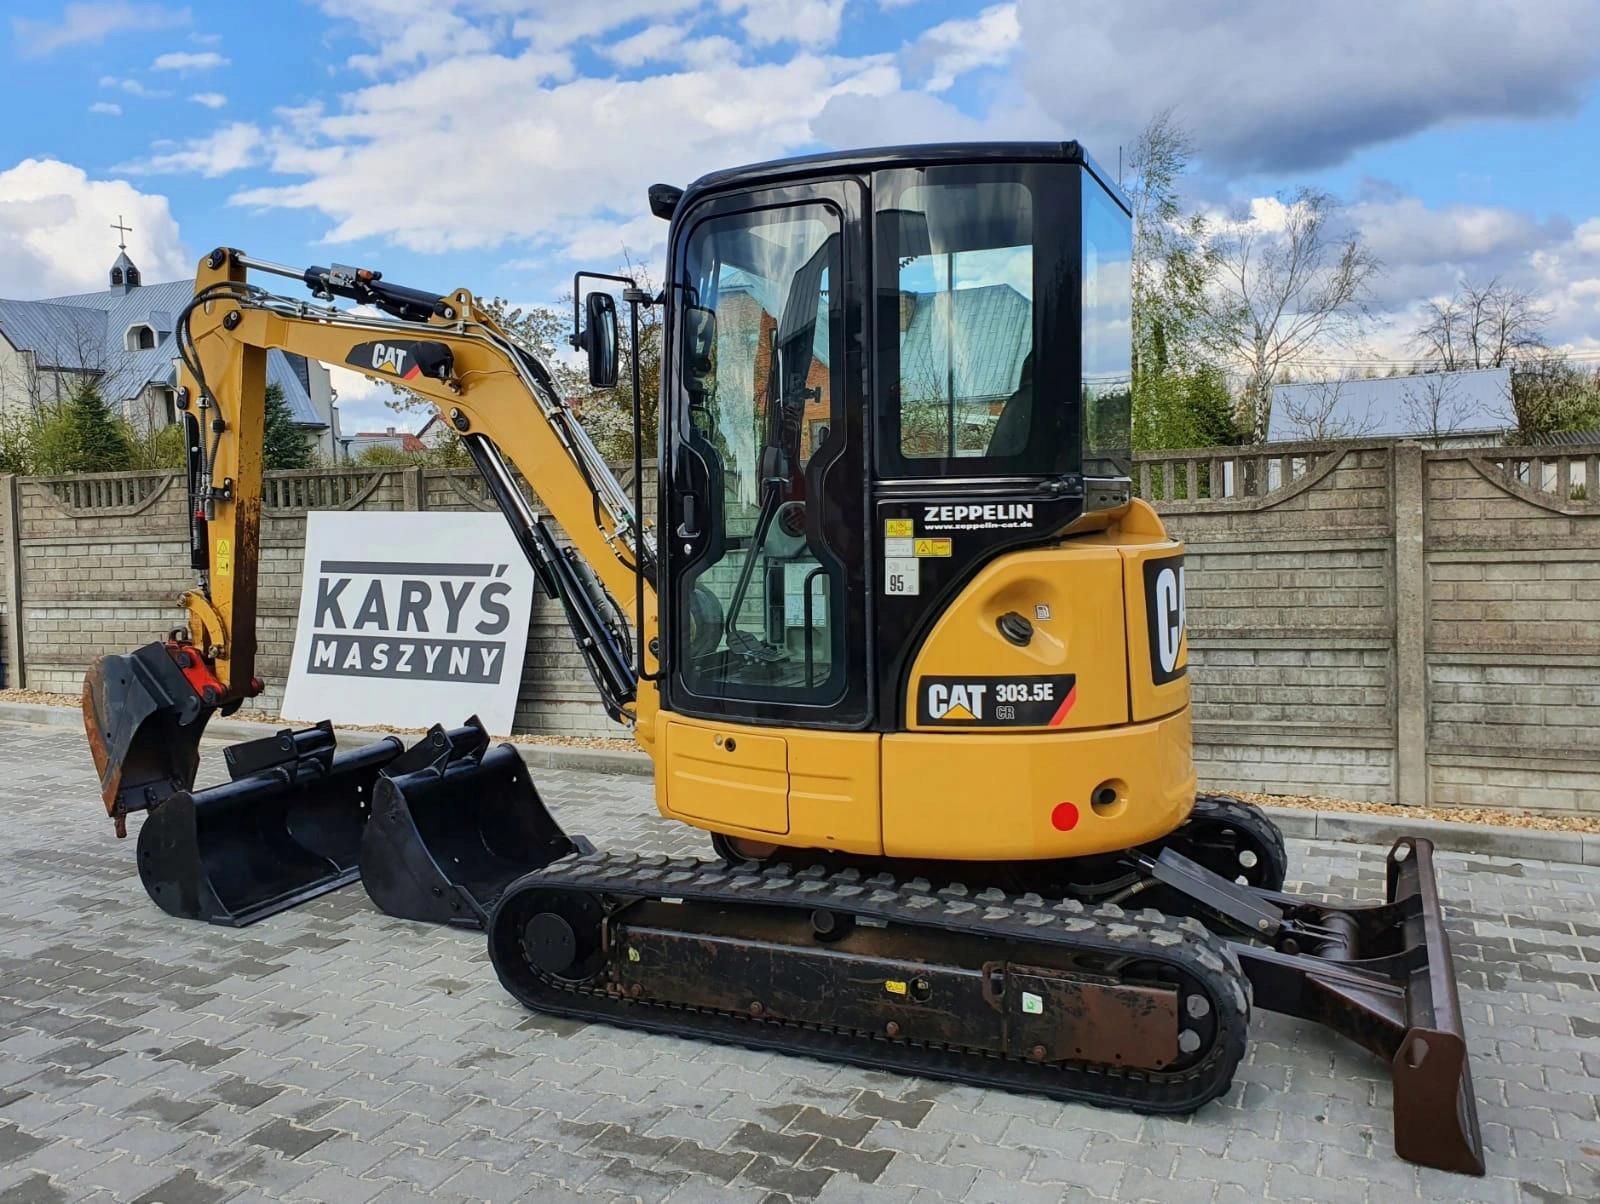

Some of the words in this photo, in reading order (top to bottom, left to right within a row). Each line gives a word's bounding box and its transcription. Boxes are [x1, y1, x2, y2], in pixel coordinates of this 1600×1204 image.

[371, 343, 407, 375] CAT
[924, 504, 1033, 521] ZEPPELIN
[924, 521, 1033, 530] www.zeppelin-cat.de
[889, 574, 904, 592] 95
[314, 564, 512, 635] KARYŚ
[313, 640, 500, 676] MASZYNY
[928, 684, 987, 720] CAT
[995, 683, 1054, 702] 303.5E
[995, 705, 1015, 720] CR
